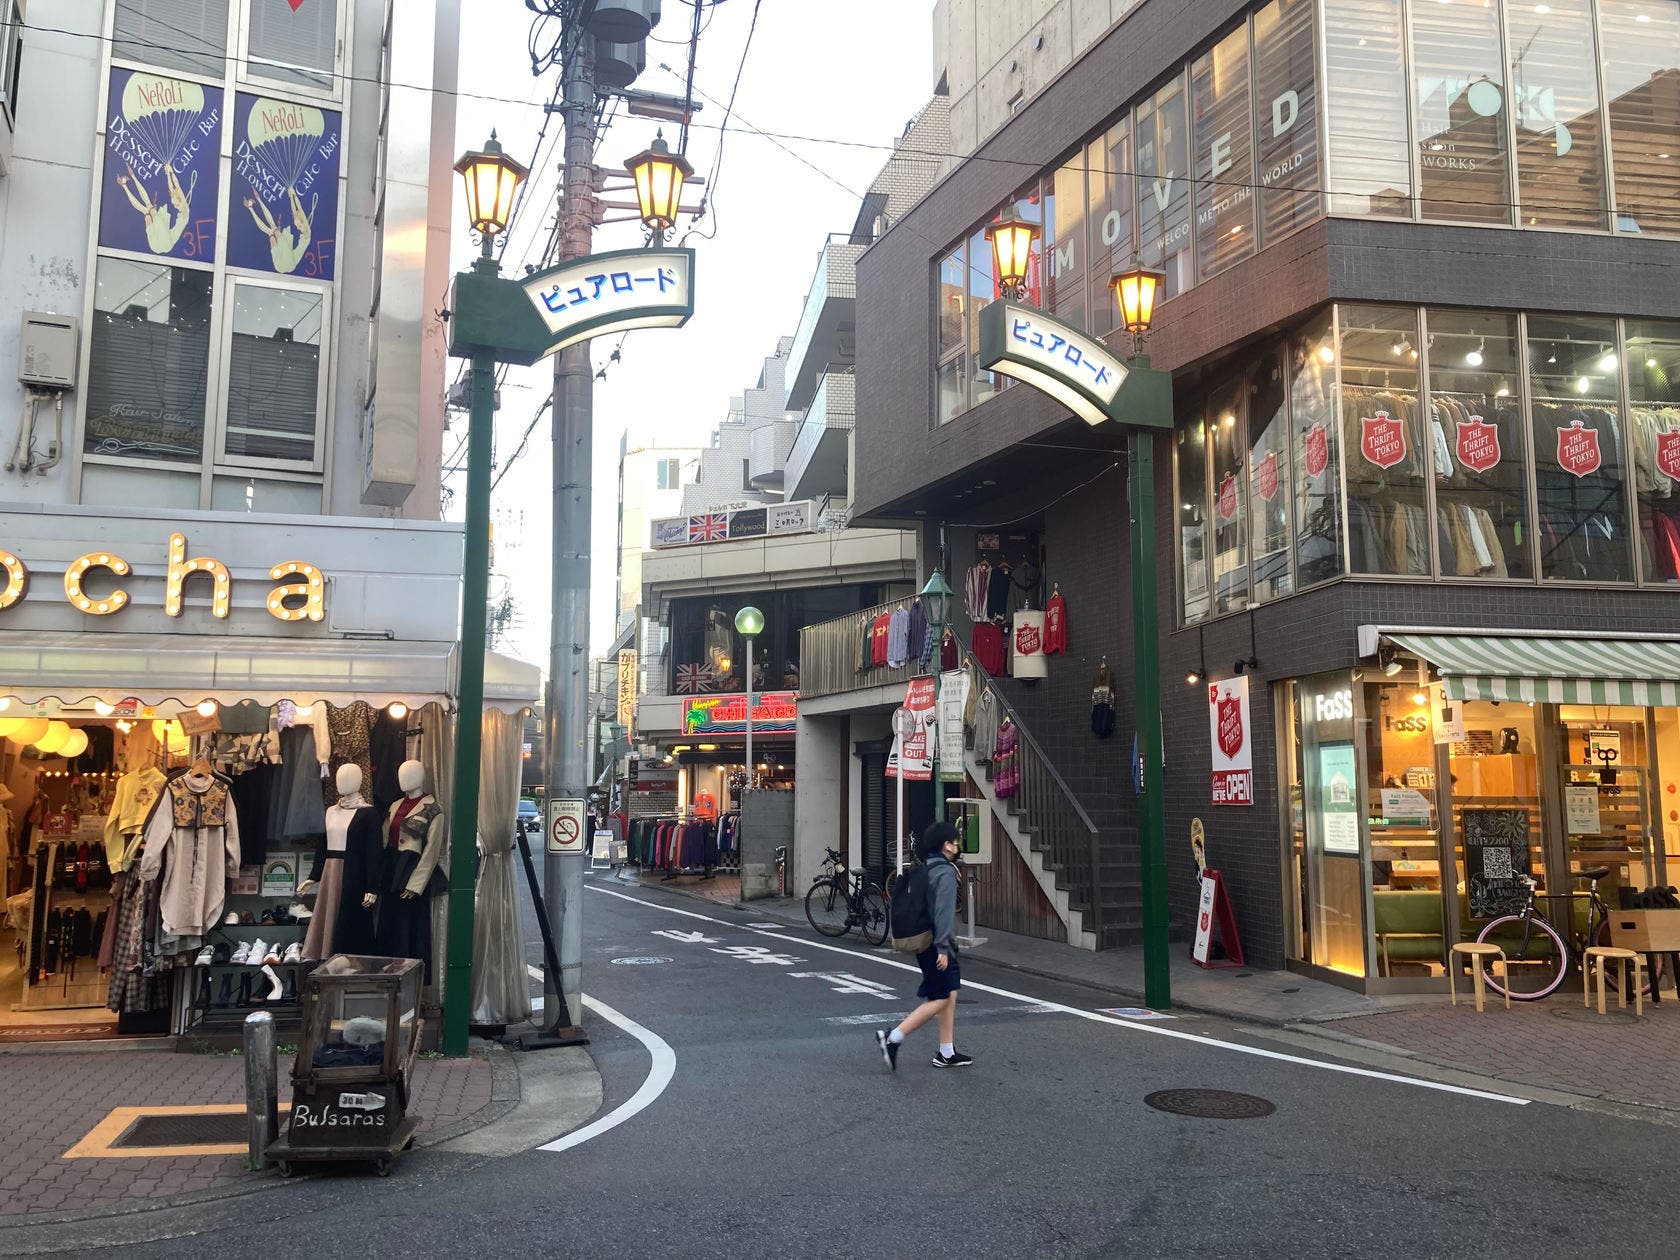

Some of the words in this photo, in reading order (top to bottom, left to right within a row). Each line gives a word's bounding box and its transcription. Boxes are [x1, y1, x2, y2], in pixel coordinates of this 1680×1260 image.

[198, 108, 219, 136] Bar
[318, 132, 338, 160] Bar
[1422, 155, 1477, 170] WORKS
[1217, 199, 1230, 214] TO
[1233, 186, 1251, 205] THE
[1262, 153, 1303, 186] WORLD
[182, 218, 214, 257] 3F
[305, 240, 335, 276] 3F
[540, 267, 676, 314] ピュアロード
[1013, 318, 1112, 385] ピュアロード
[1373, 423, 1387, 436] THE
[1467, 427, 1482, 440] THE
[1569, 433, 1582, 445] THE
[1368, 431, 1394, 449] THRIFT
[1375, 440, 1400, 460] TOKYO
[1463, 435, 1489, 453] THRIFT
[1564, 440, 1590, 458] THRIFT
[1667, 437, 1680, 449] THE
[1469, 444, 1494, 464] TOKYO
[1570, 449, 1595, 469] TOKYO
[732, 521, 765, 533] Tollywood
[1223, 702, 1232, 719] THE
[1220, 711, 1237, 737] THRIFT
[912, 735, 926, 743] AKE
[1224, 723, 1241, 751] TOKYO
[905, 750, 923, 758] OUT
[1226, 773, 1250, 801] OPEN
[292, 1104, 385, 1129] Bulsaras
